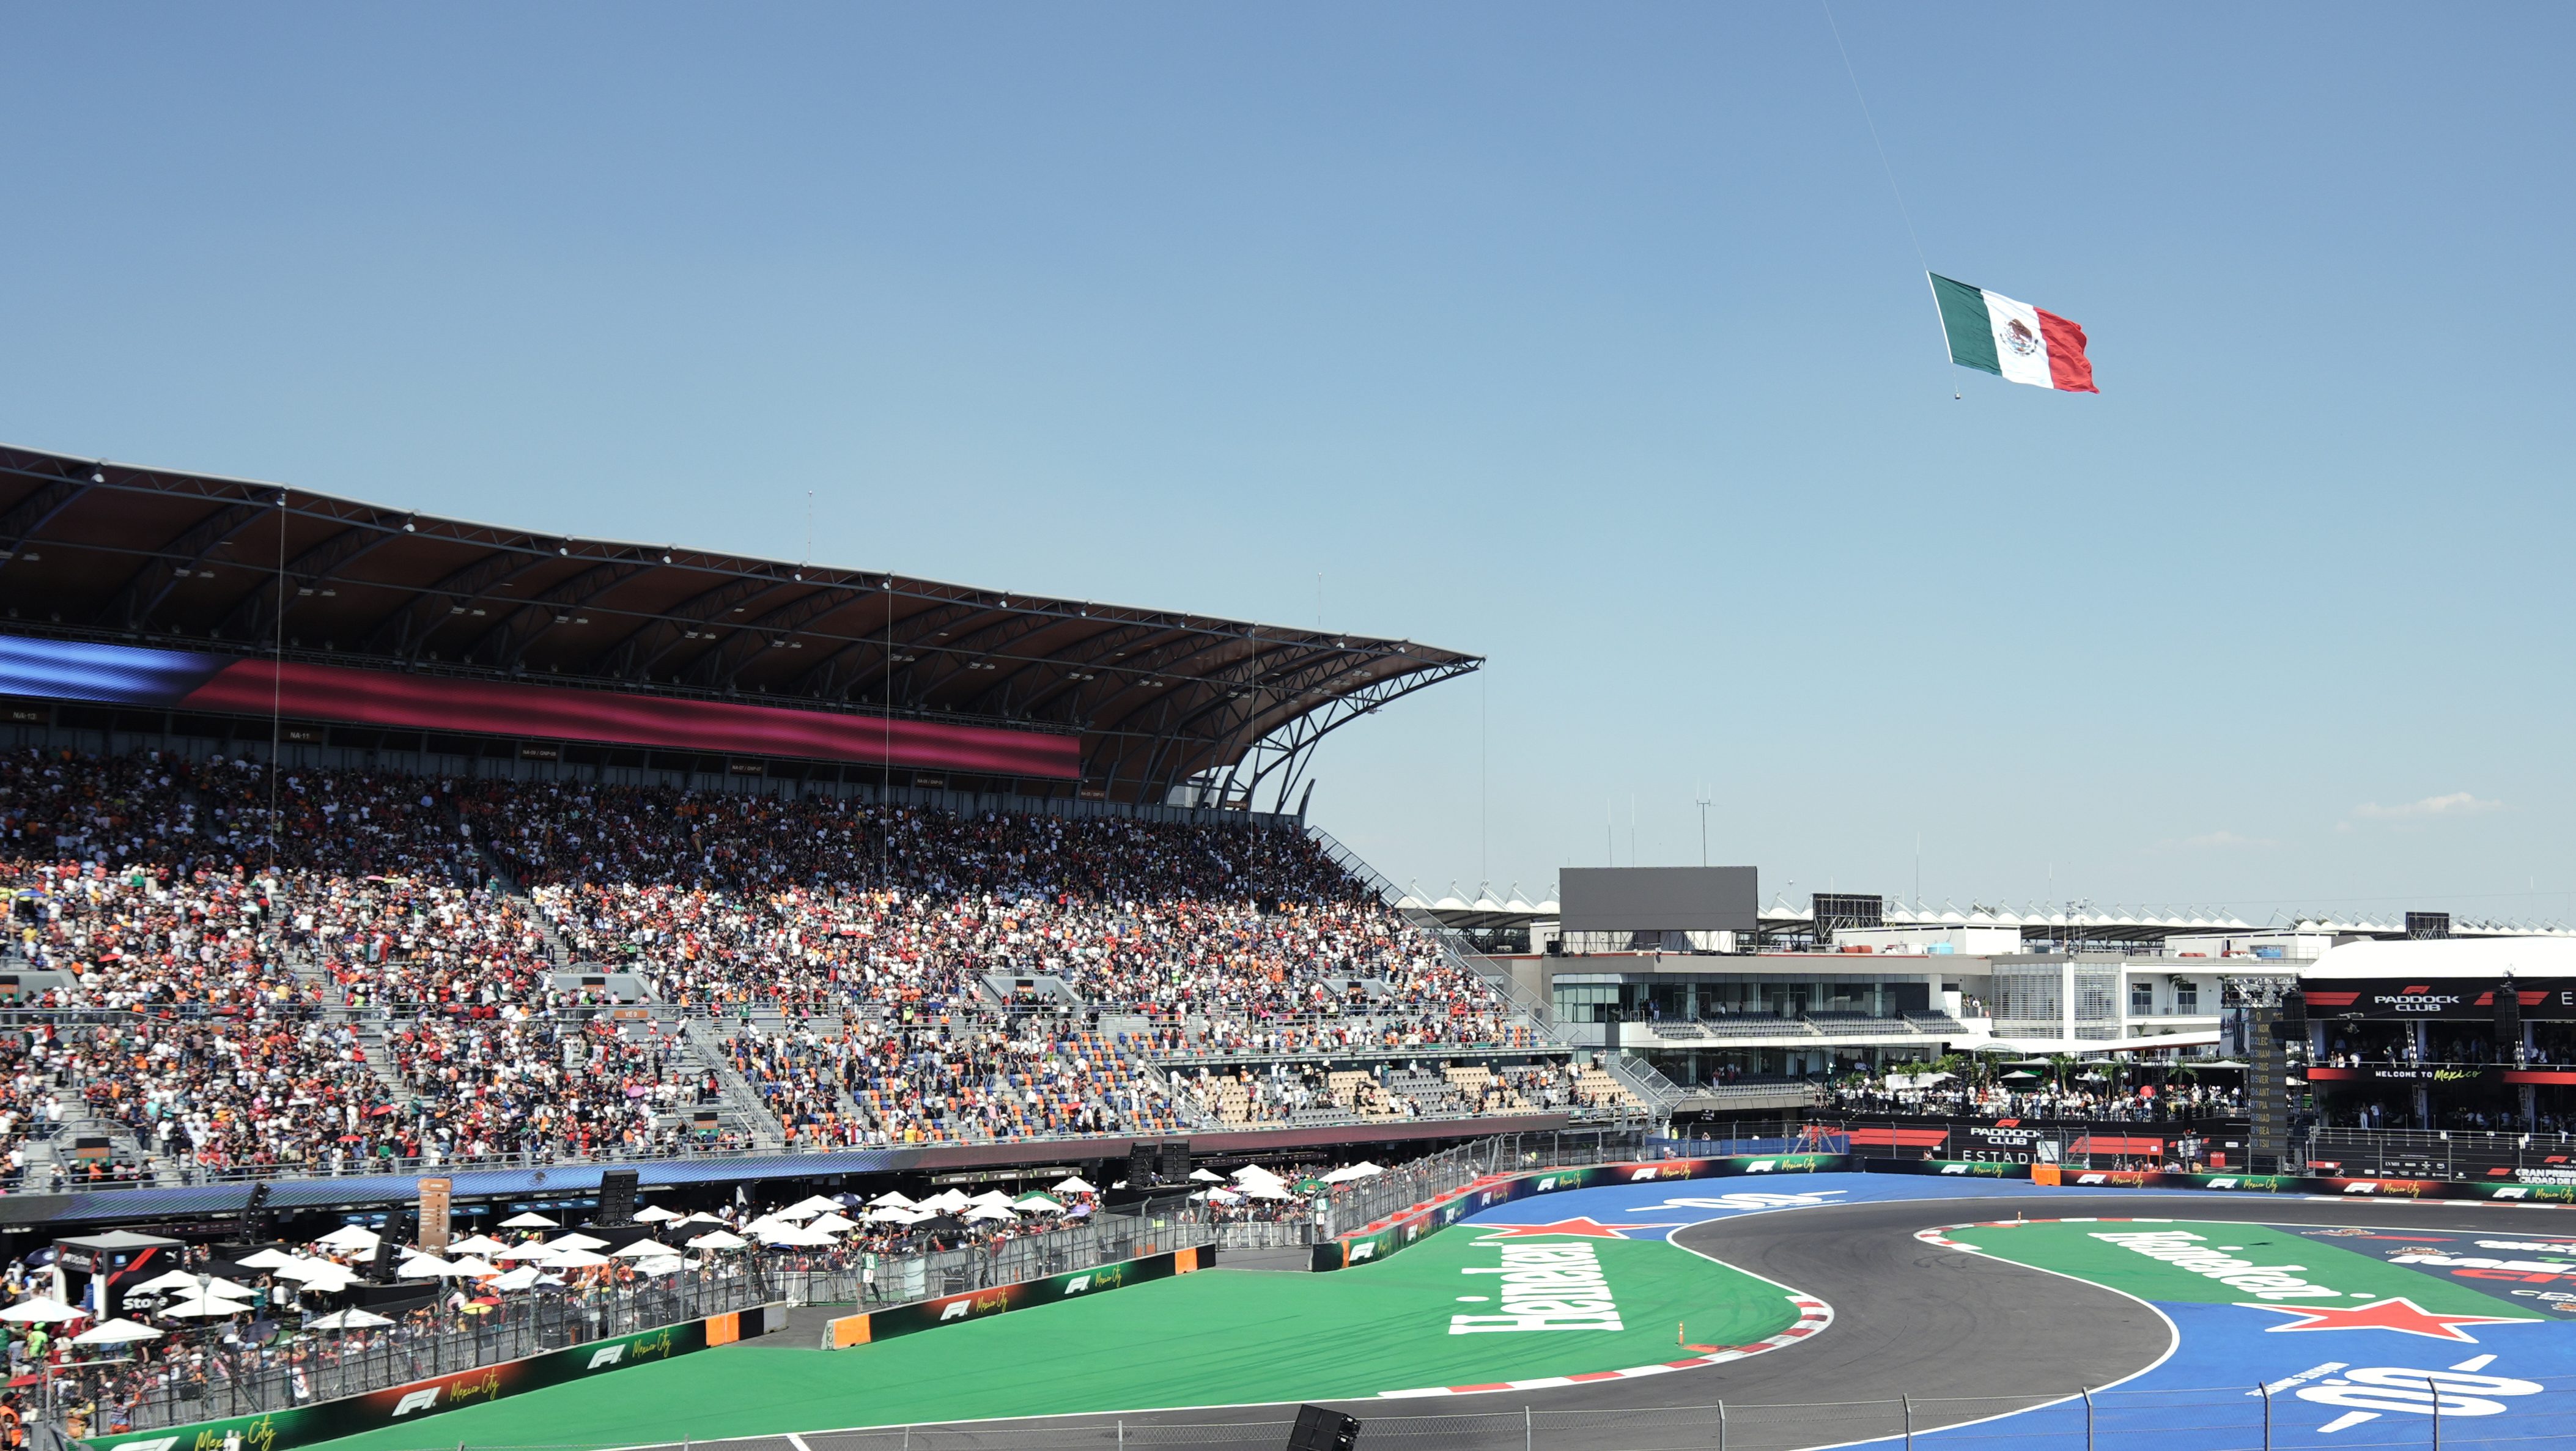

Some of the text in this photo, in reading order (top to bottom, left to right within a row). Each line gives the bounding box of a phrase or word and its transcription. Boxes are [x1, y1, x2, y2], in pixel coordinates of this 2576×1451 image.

[2374, 995, 2459, 1004] PADDOCK
[2395, 1003, 2441, 1012] CLUB
[2250, 1024, 2270, 1033] 01 NOR
[2250, 1036, 2268, 1046] 02 LEC
[2250, 1062, 2269, 1071] 04 RUS
[2250, 1075, 2269, 1084] 05 VER
[2434, 1069, 2482, 1082] Mexico
[2250, 1088, 2270, 1097] 06 ANT
[2251, 1100, 2268, 1110] 07 PIA
[2251, 1113, 2259, 1122] 08
[2251, 1126, 2270, 1135] 09 BEA
[1988, 1137, 2028, 1145] CLUB
[2251, 1139, 2269, 1148] 10 TSU
[1963, 1150, 2037, 1164] ESTADI
[1662, 1166, 1680, 1178] Mexico
[1680, 1161, 1691, 1180] City
[1782, 1159, 1803, 1171] Mexico
[1803, 1156, 1817, 1173] City
[1973, 1165, 1991, 1175] Mexico
[1992, 1163, 2003, 1179] City
[2111, 1174, 2132, 1185] Mexico
[2132, 1170, 2144, 1189] City
[2515, 1169, 2545, 1178] GRAN
[2243, 1178, 2264, 1190] Mexico
[2265, 1175, 2279, 1194] City
[2383, 1183, 2407, 1194] Mexico
[2407, 1180, 2421, 1198] City
[2535, 1187, 2559, 1200] Mexico
[2560, 1186, 2574, 1204] City
[2087, 1230, 2342, 1299] Heineken
[1095, 1272, 1112, 1288] Mexico
[1112, 1265, 1121, 1288] City
[1449, 1242, 1624, 1335] Heineken
[122, 1296, 169, 1310] Stoe
[976, 1295, 996, 1313] Mexico
[997, 1287, 1008, 1313] City
[632, 1339, 656, 1359] Mexico
[657, 1328, 671, 1358] City
[449, 1379, 481, 1403] Mexico
[482, 1368, 500, 1400] City
[248, 1414, 277, 1451] City
